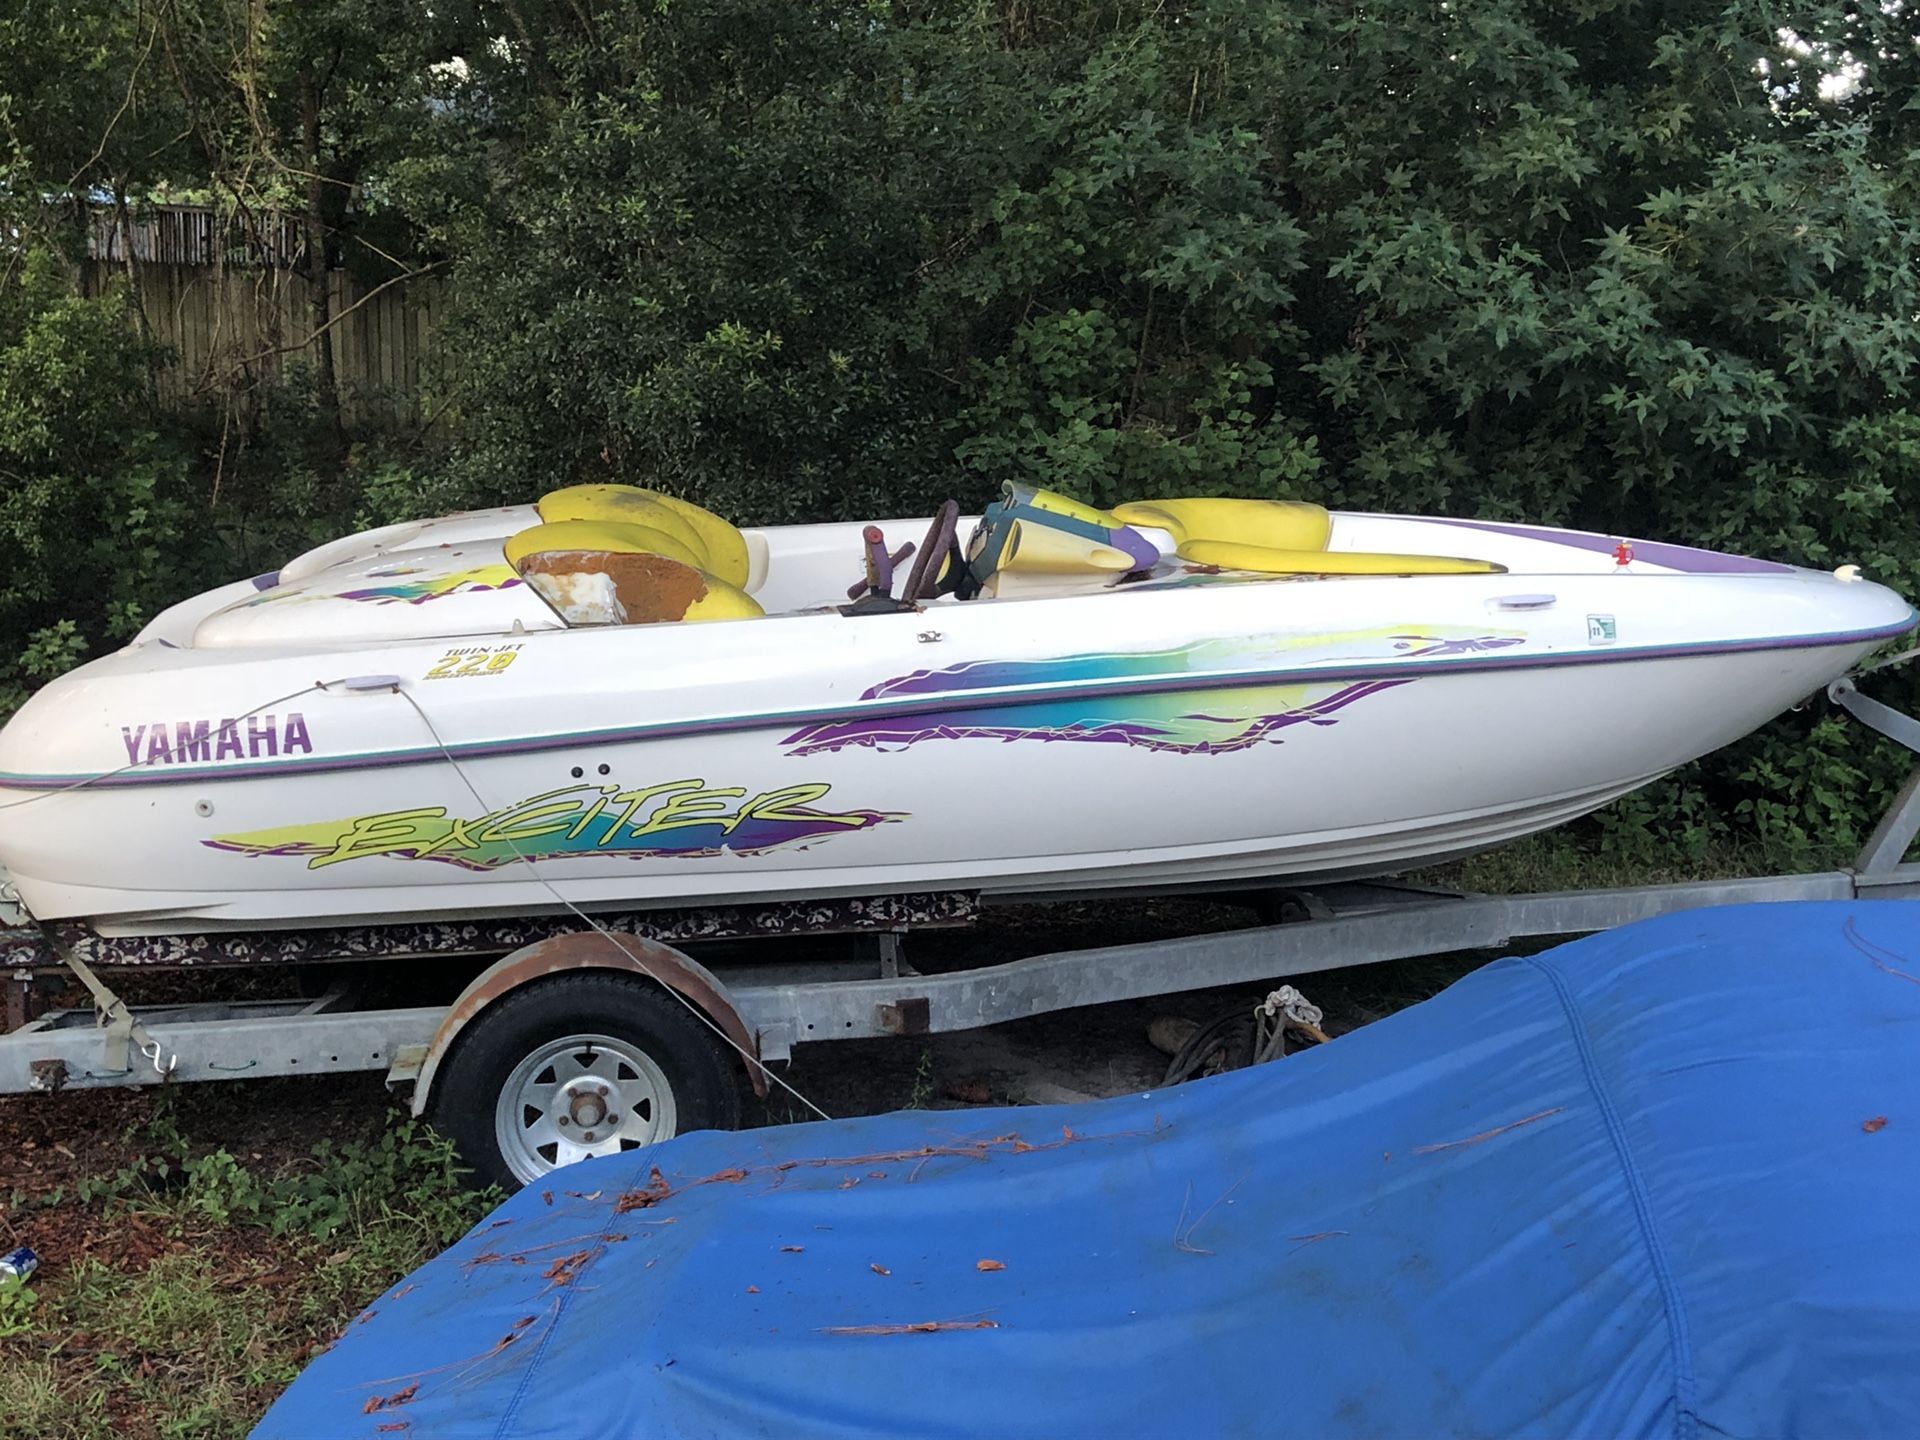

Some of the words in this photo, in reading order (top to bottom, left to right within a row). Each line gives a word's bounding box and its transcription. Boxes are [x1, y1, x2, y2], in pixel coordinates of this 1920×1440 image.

[428, 651, 517, 675] 220
[445, 646, 492, 656] TWIN
[121, 712, 313, 766] YAMAHA
